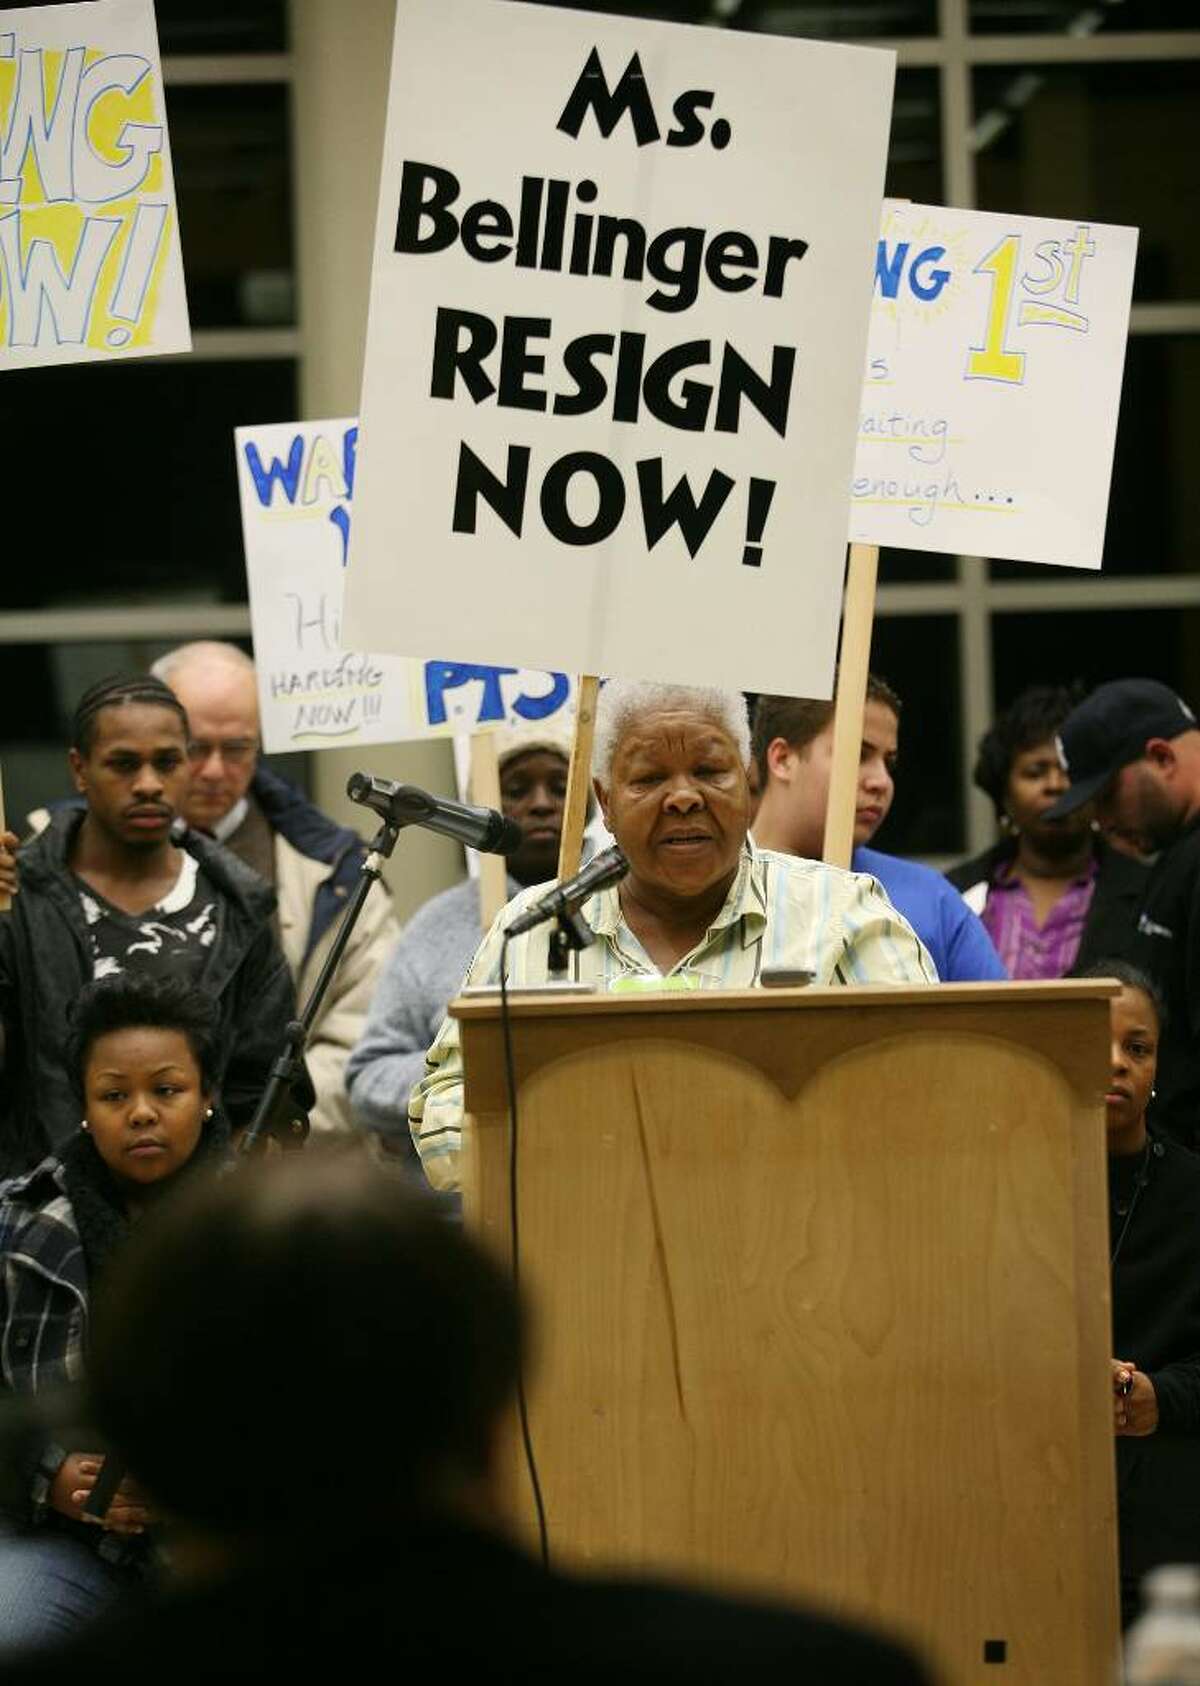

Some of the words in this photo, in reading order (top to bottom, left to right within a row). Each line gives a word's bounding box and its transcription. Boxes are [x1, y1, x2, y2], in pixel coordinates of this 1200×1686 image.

[556, 45, 732, 150] Ms.
[394, 160, 809, 313] Bellinger
[963, 225, 1096, 385] 1st
[430, 306, 797, 439] RESIGN
[452, 439, 777, 567] NOW!
[857, 414, 948, 465] aiting
